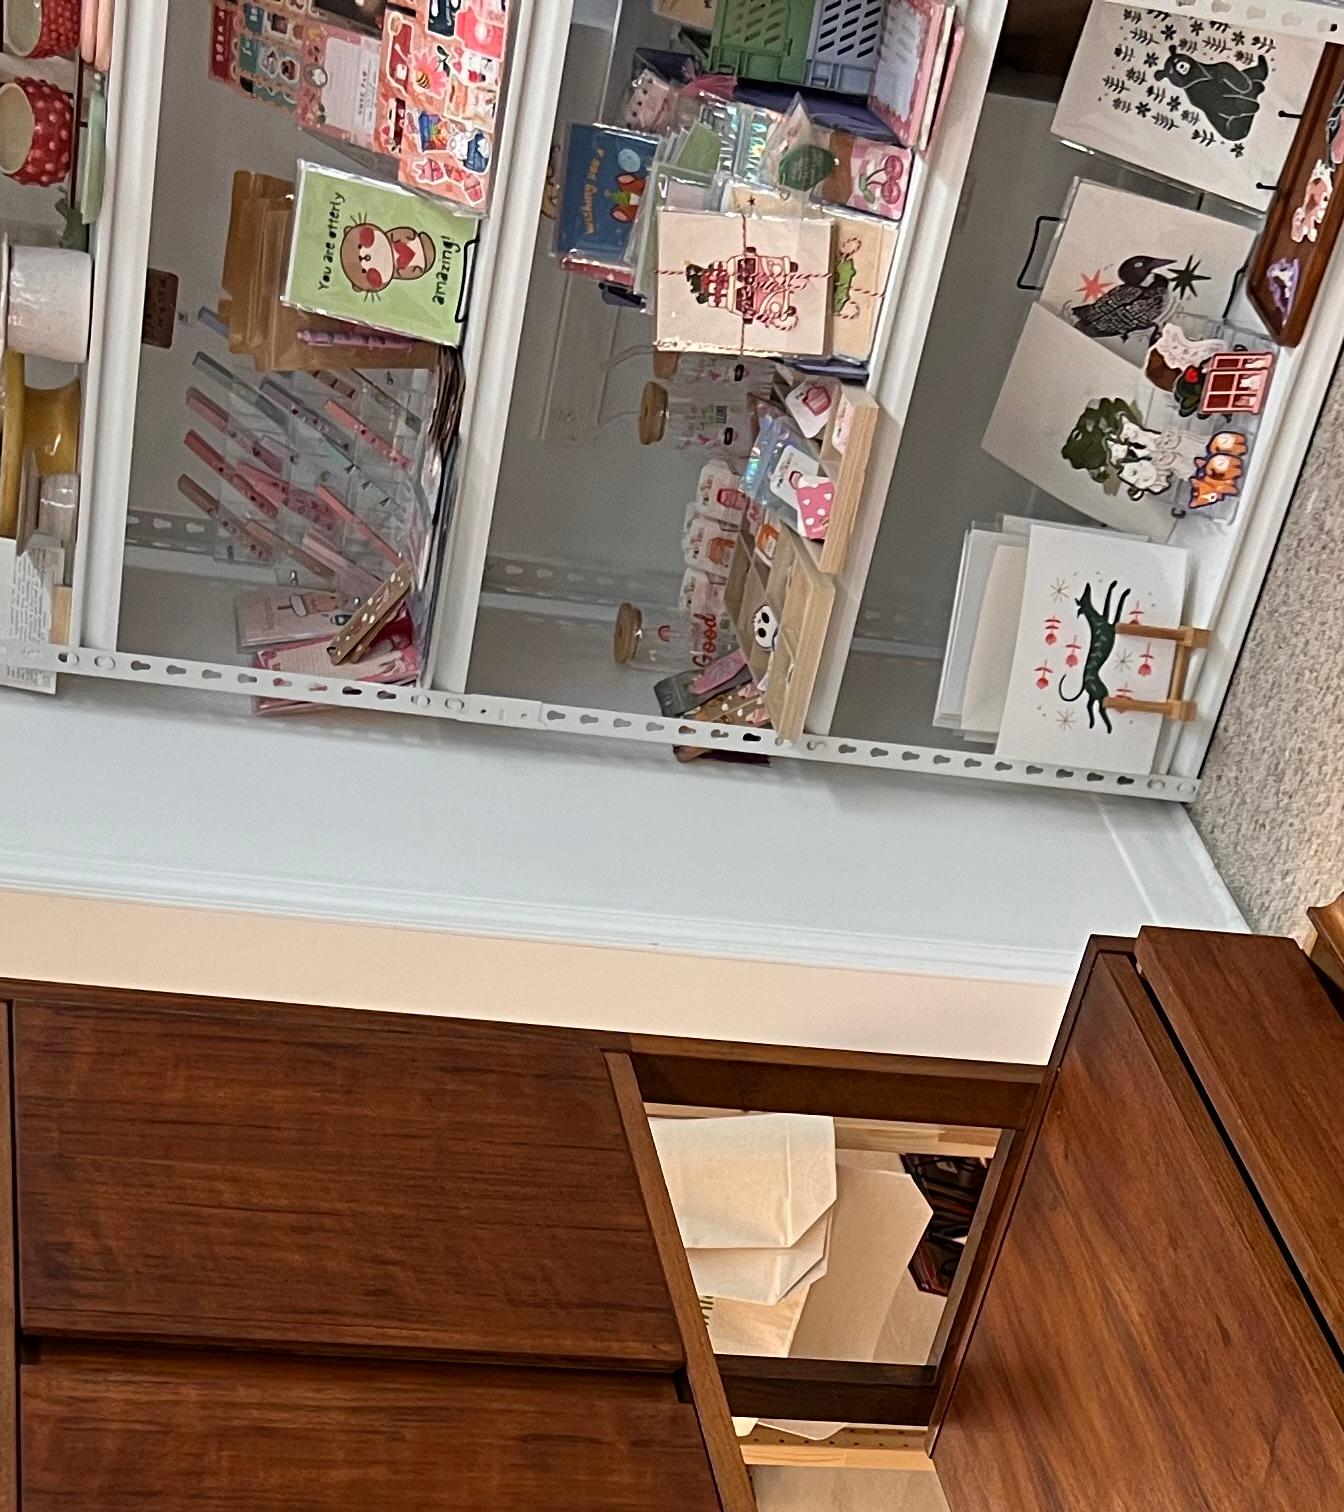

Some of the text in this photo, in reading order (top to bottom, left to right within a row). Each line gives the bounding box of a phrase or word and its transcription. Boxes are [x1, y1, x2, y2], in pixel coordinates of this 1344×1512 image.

[317, 191, 346, 291] You are otterly
[432, 235, 461, 305] amazing!
[692, 613, 717, 667] Good
